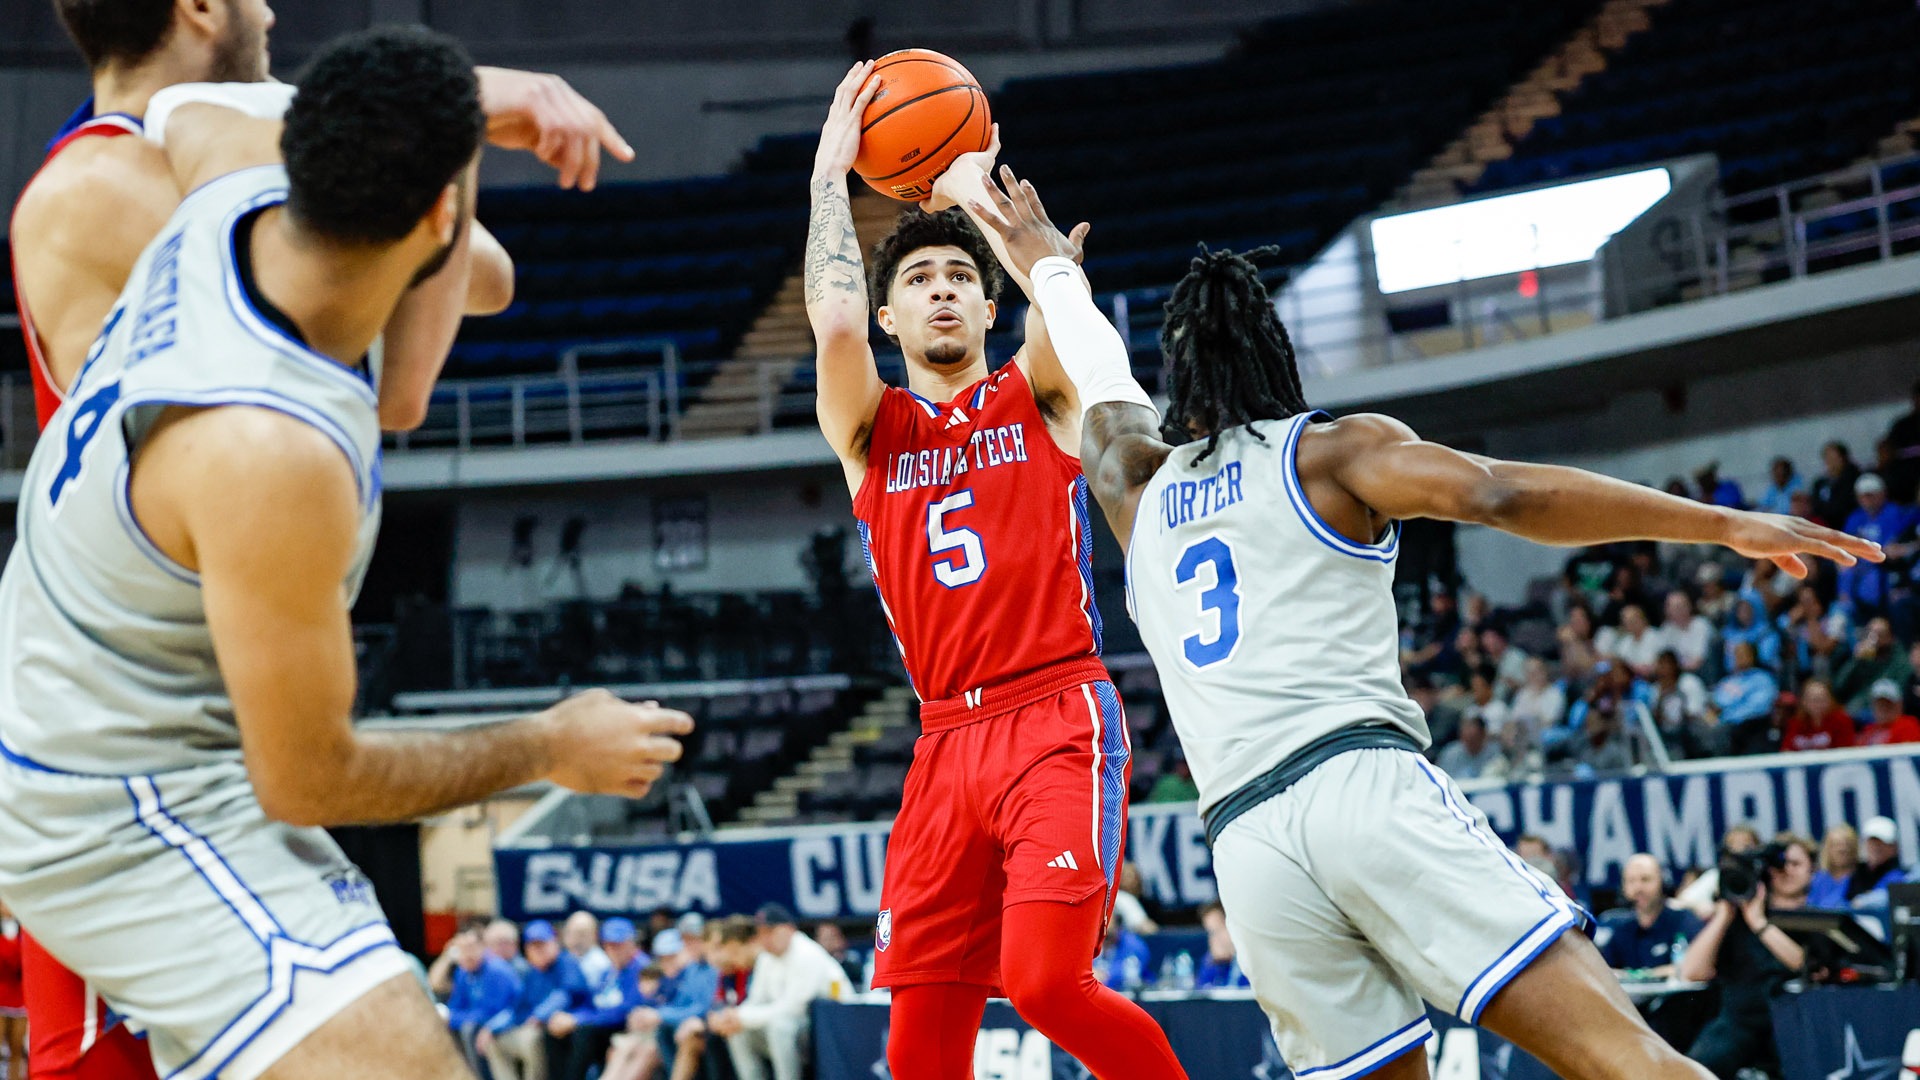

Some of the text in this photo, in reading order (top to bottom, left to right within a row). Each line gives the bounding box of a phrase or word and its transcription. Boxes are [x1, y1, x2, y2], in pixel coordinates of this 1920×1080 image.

[970, 422, 1028, 471] TECH
[927, 487, 988, 590] 5
[1160, 460, 1243, 536] PORTER
[1173, 534, 1241, 671] 3
